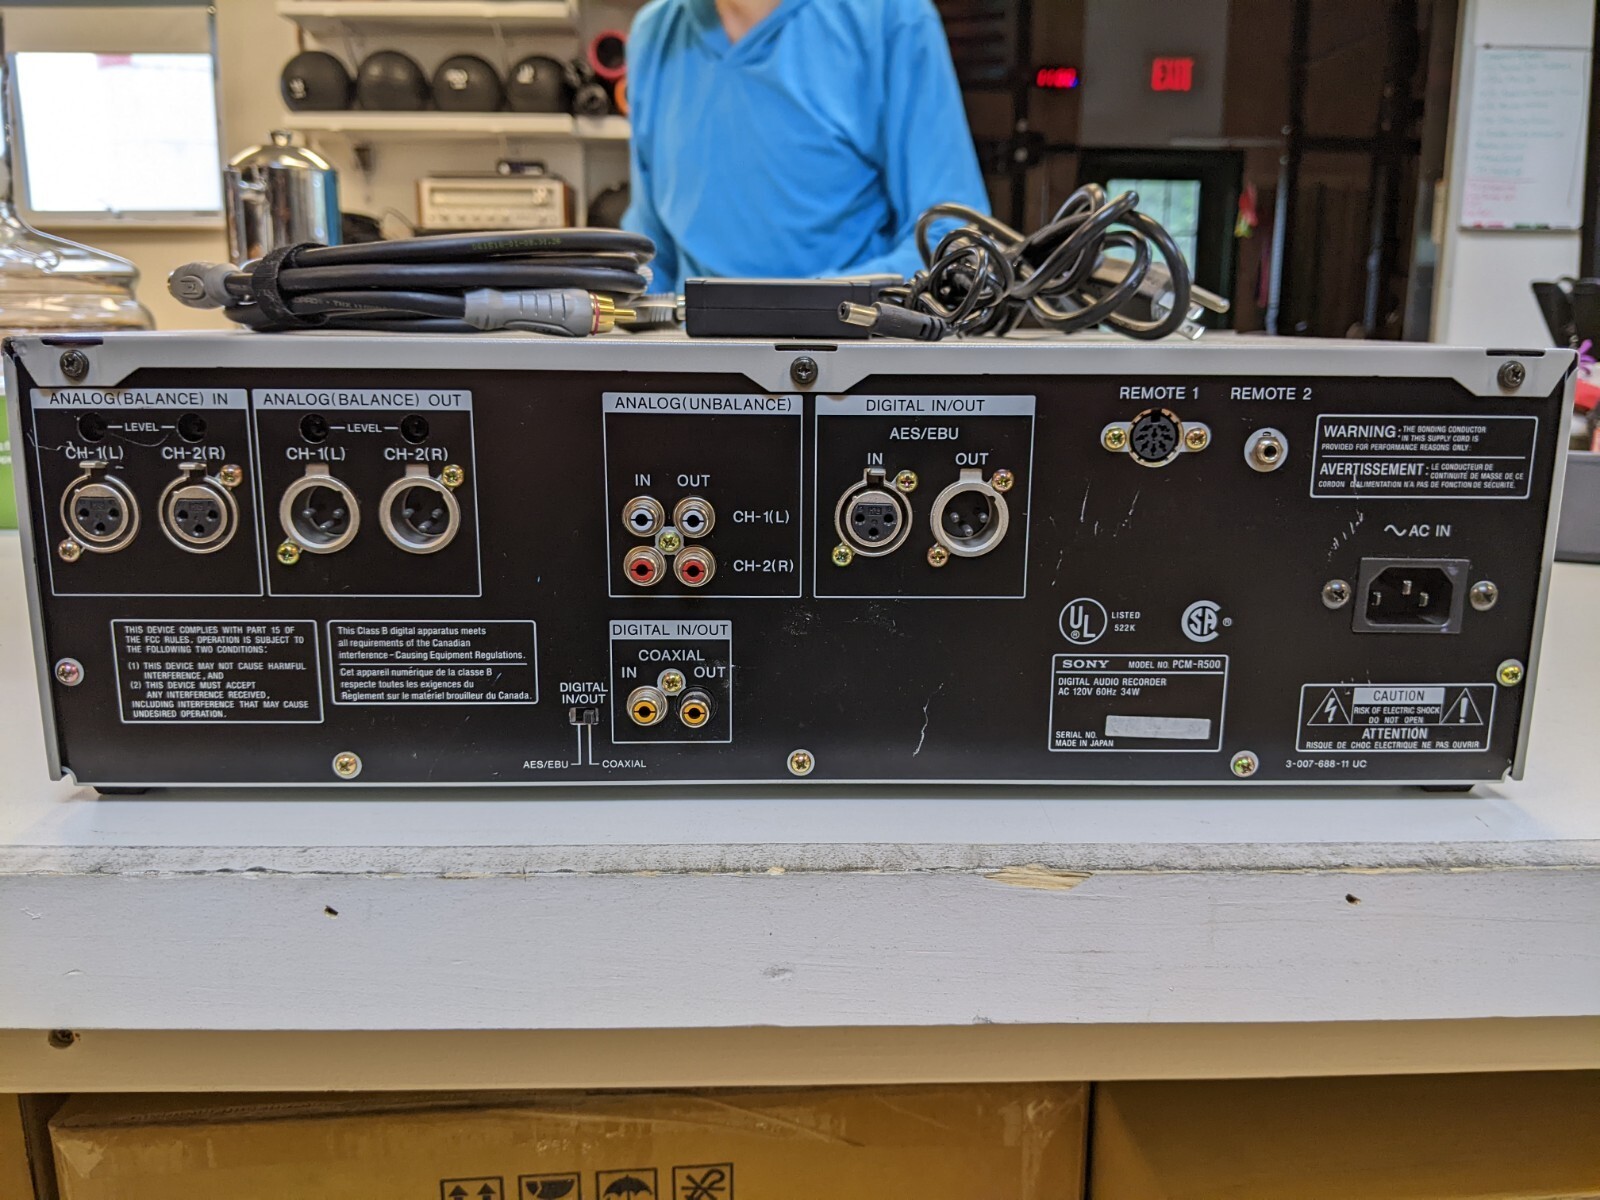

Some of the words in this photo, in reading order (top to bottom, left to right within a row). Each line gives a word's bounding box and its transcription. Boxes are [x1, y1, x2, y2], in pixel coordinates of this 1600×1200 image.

[1120, 387, 1186, 399] REMOTE
[1193, 387, 1199, 399] 1
[1231, 387, 1296, 400] REMOTE
[1303, 388, 1312, 400] 2
[50, 392, 204, 407] ANALOG(BALANCE)
[213, 393, 228, 406] IN
[264, 393, 420, 407] ANALOG(BALANCE)
[429, 394, 461, 407] OUT
[615, 397, 792, 412] ANALOG(UNBALANCE)
[866, 399, 925, 412] DIGITAL
[931, 399, 985, 412] IN/OUT
[124, 422, 159, 433] LEVEL
[348, 423, 383, 434] LEVEL
[889, 427, 959, 440] AES/EBU
[1370, 443, 1418, 451] PERFORMANCE
[65, 446, 124, 460] CH-1(L)
[162, 446, 226, 461] CH-2(R)
[286, 446, 346, 461] CH-1(L)
[384, 447, 449, 462] CH-2(R)
[867, 453, 883, 465] IN
[955, 453, 989, 465] OUT
[634, 474, 651, 486] IN
[677, 474, 710, 487] OUT
[733, 510, 790, 524] CH-1(L)
[1408, 524, 1430, 537] AC
[1436, 524, 1451, 537] IN
[733, 559, 794, 574] CH-2(R)
[124, 626, 143, 634] THIS
[147, 626, 175, 634] DEVICE
[179, 626, 218, 634] COMPLIES
[222, 626, 243, 634] WITH
[247, 626, 266, 634] PART
[271, 626, 280, 634] 15
[337, 627, 355, 635] This
[357, 627, 380, 635] Class
[381, 627, 388, 635] B
[390, 627, 416, 636] digital
[417, 627, 459, 636] apparatus
[461, 627, 486, 635] meets
[613, 625, 670, 636] DIGITAL
[677, 624, 728, 636] IN/OUT
[1114, 624, 1136, 632] 522K
[197, 636, 240, 644] OPERATION
[255, 636, 289, 644] SUBJECT
[338, 639, 349, 647] all
[350, 639, 404, 648] requirements
[417, 639, 430, 647] the
[432, 639, 471, 647] Canadian
[429, 651, 473, 660] Equipment
[638, 649, 705, 661] COAXIAL
[143, 662, 162, 670] THIS
[166, 662, 194, 670] DEVICE
[198, 662, 214, 670] MAY
[219, 662, 233, 670] NOT
[238, 662, 264, 670] CAUSE
[268, 662, 306, 670] HARMFUL
[1062, 660, 1109, 668] SONY
[1128, 661, 1155, 669] MODEL
[1172, 660, 1221, 669] PCM-R500
[340, 668, 354, 676] Cet
[356, 668, 389, 677] appareil
[435, 668, 446, 676] de
[457, 668, 485, 676] classe
[486, 668, 492, 676] B
[622, 667, 637, 678] IN
[694, 667, 726, 678] OUT
[145, 681, 164, 689] THIS
[168, 681, 196, 689] DEVICE
[200, 681, 222, 689] MUST
[226, 681, 256, 689] ACCEPT
[341, 681, 377, 689] respecte
[378, 680, 405, 688] toutes
[406, 680, 419, 688] les
[420, 680, 461, 690] exigences
[464, 680, 474, 688] du
[560, 682, 608, 693] DIGITAL
[1058, 678, 1090, 686] DIGITAL
[1093, 678, 1119, 686] AUDIO
[1122, 678, 1167, 686] RECORDER
[147, 691, 163, 699] ANY
[167, 691, 224, 699] INTERFERENCE
[446, 692, 483, 700] brouilleur
[486, 692, 496, 700] du
[1096, 688, 1116, 696] 60Hz
[1121, 688, 1140, 696] 34W
[1373, 691, 1425, 701] CAUTION
[562, 694, 606, 704] IN/OUT
[133, 710, 177, 718] UNDESIRED
[1362, 728, 1428, 739] ATTENTION
[1055, 739, 1077, 747] MADE
[1306, 741, 1333, 749] RISQUE
[1351, 741, 1371, 749] CHOC
[1421, 741, 1432, 749] NE
[523, 761, 569, 769] AES/EBU
[602, 760, 646, 768] COAXIAL
[1286, 760, 1349, 768] 3-007-688-11
[1353, 760, 1367, 768] UC
